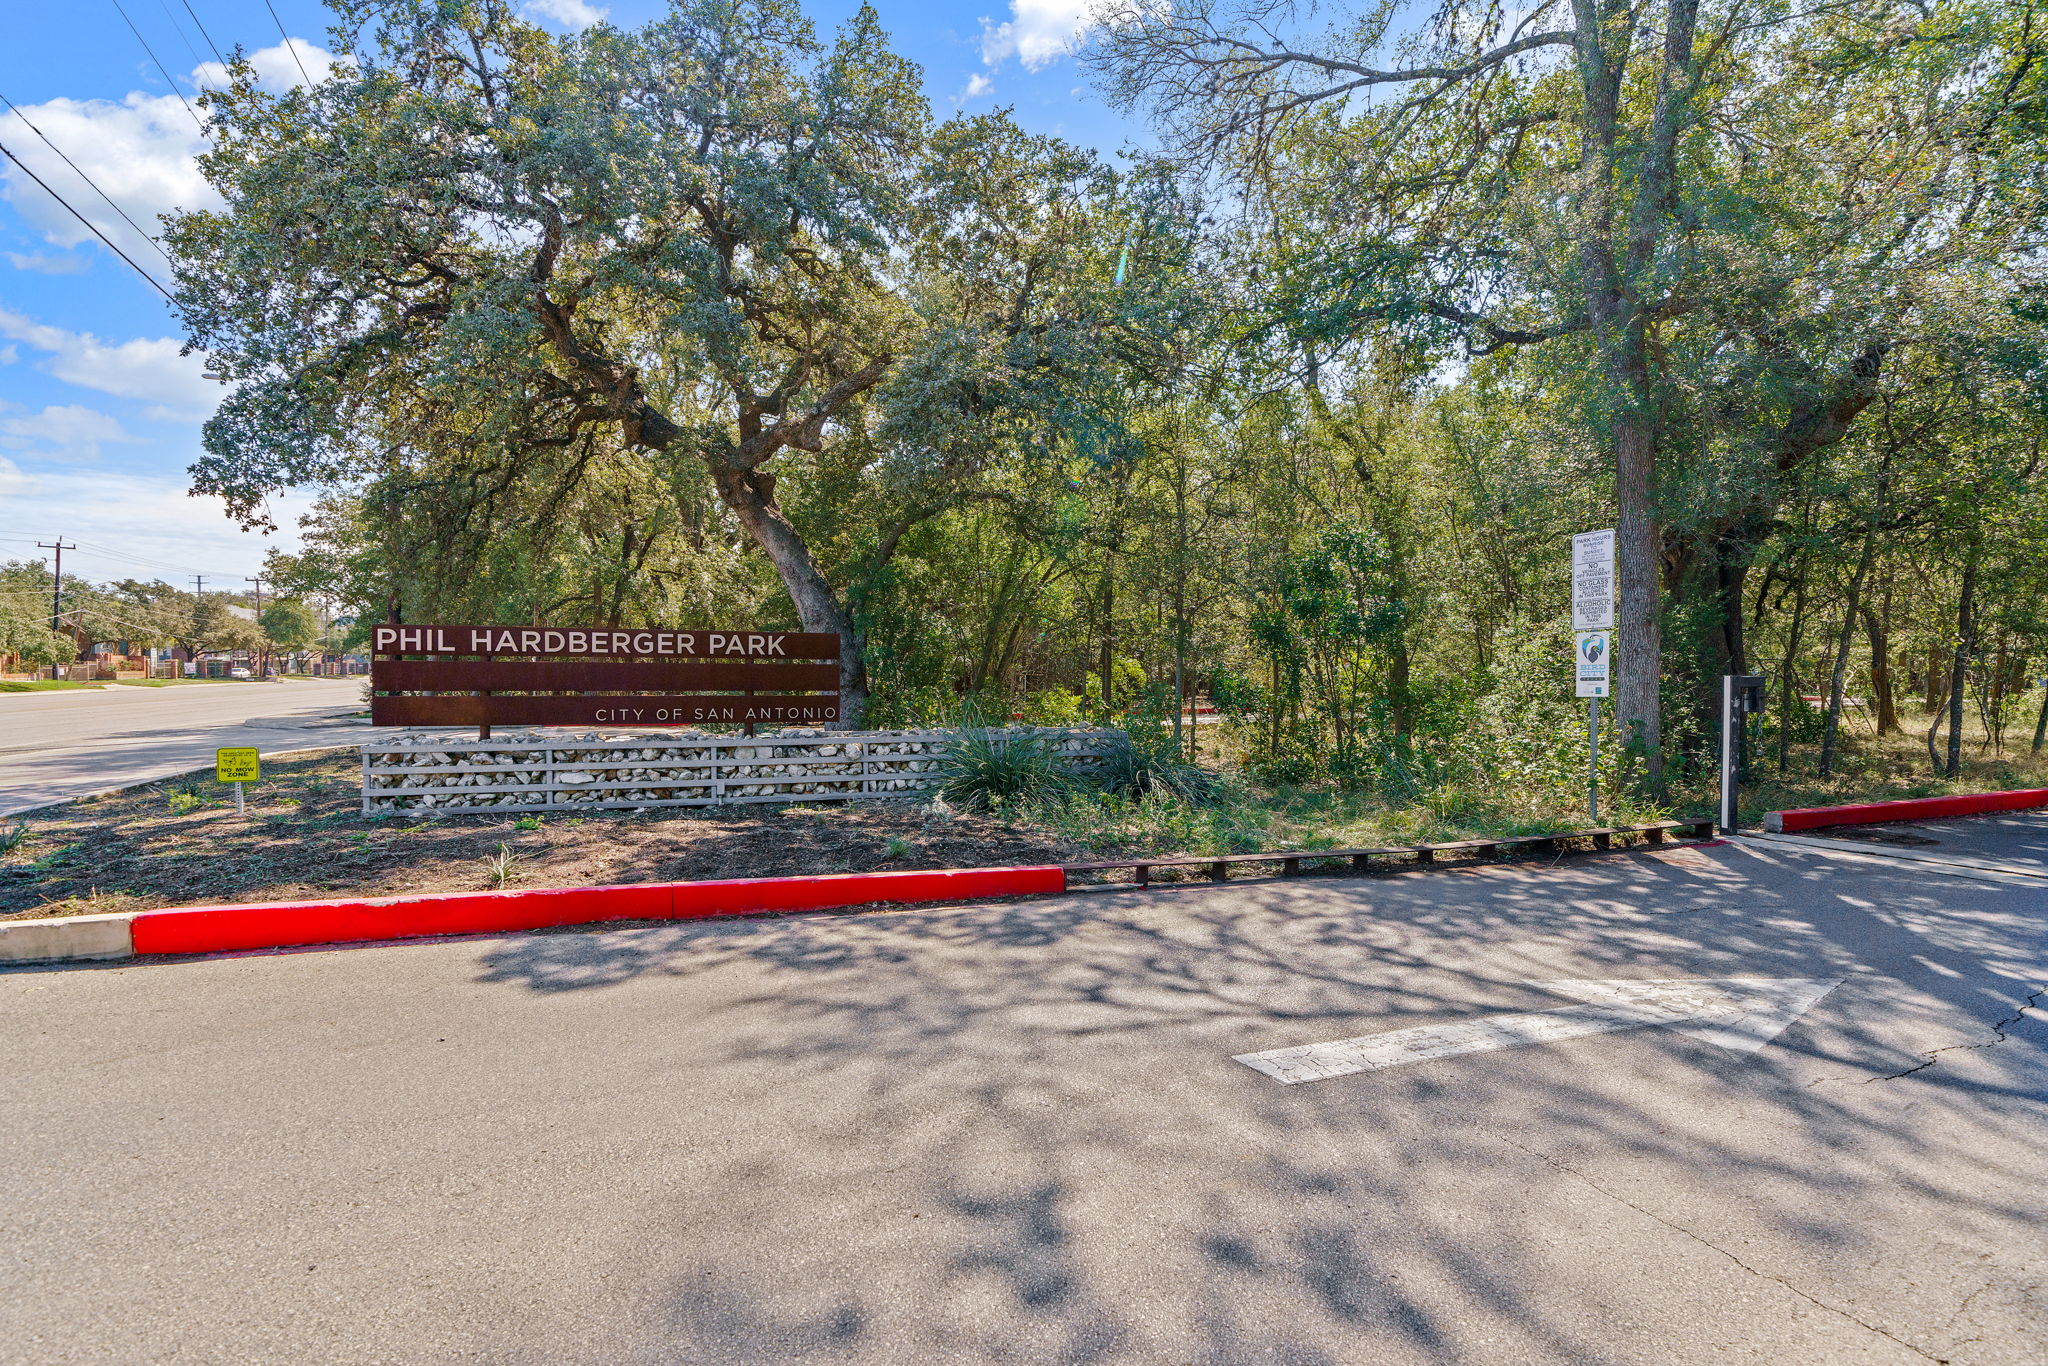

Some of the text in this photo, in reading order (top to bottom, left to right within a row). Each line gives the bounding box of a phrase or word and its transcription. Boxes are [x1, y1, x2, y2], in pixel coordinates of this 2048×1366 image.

[1576, 600, 1610, 608] ALCOHOLIC
[377, 628, 786, 656] PHIL HARDBERGER PARK
[595, 707, 836, 721] CITY OF SAN ANTONIO
